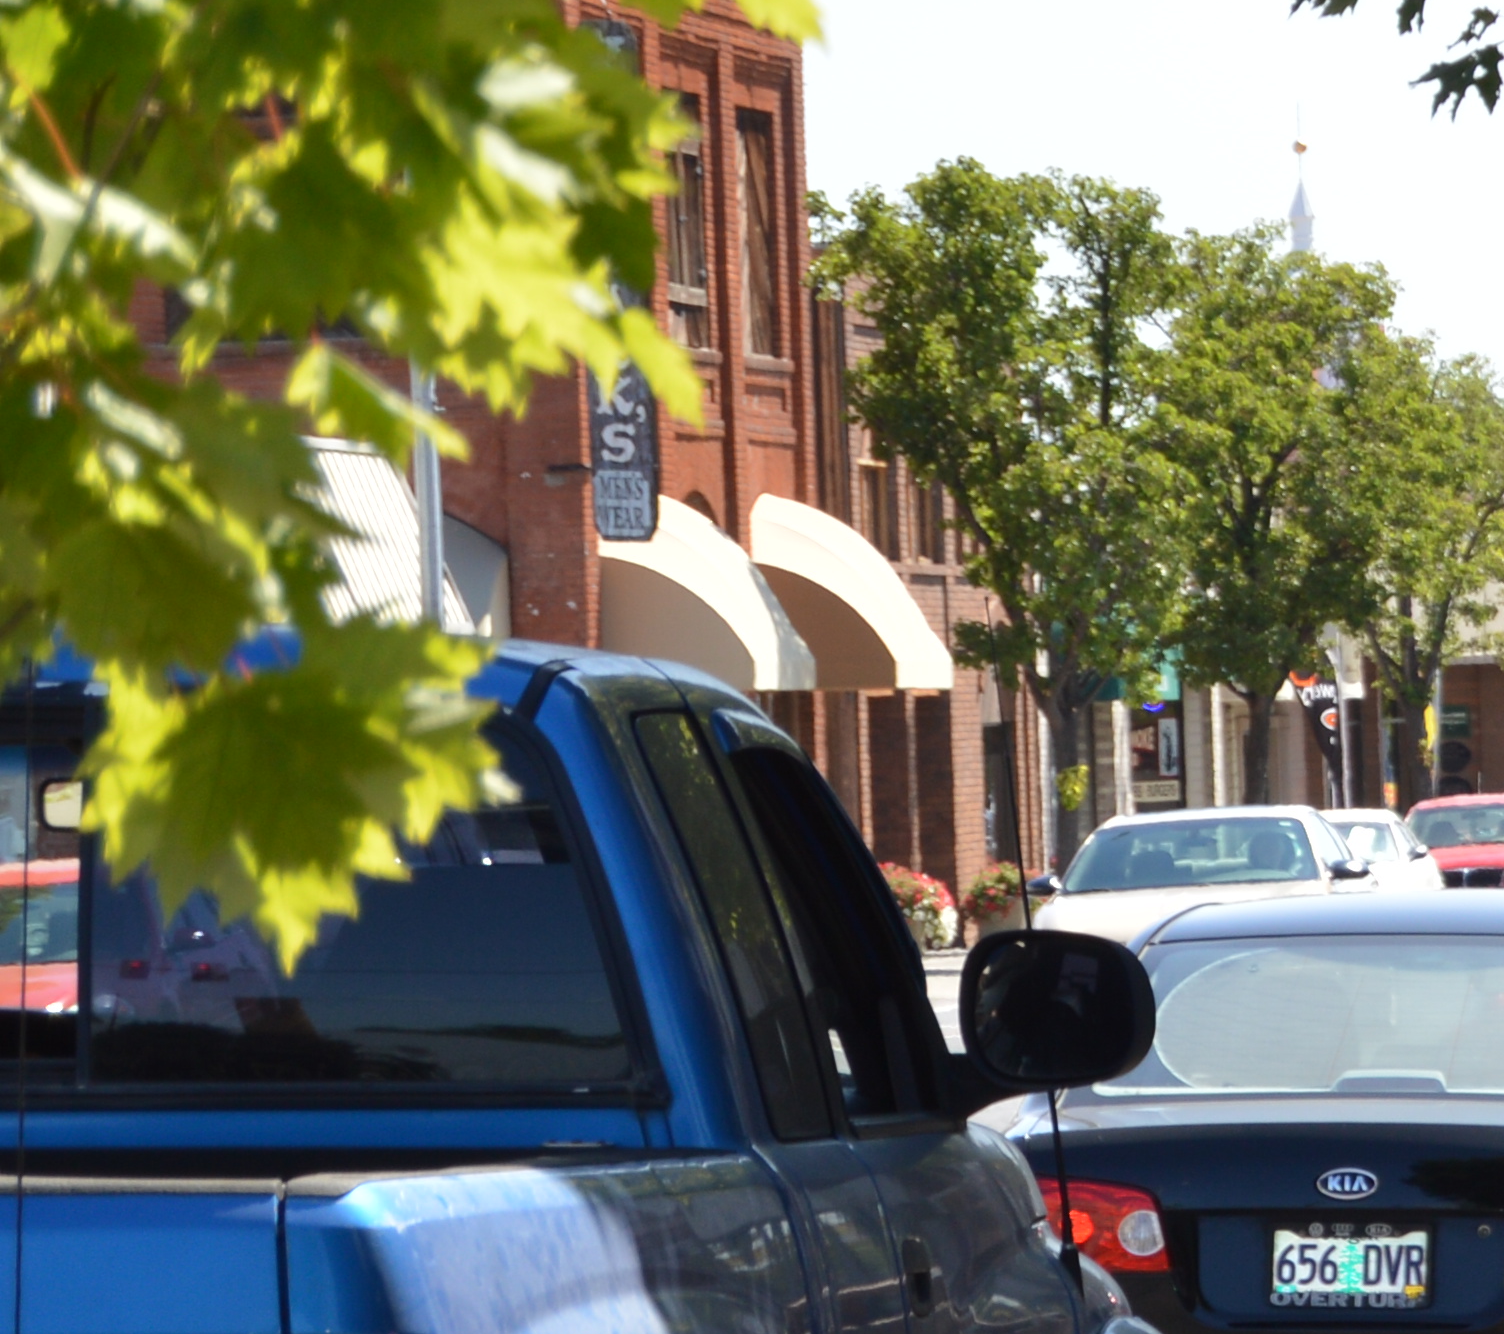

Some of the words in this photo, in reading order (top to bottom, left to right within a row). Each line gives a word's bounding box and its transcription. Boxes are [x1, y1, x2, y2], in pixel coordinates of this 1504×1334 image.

[1327, 1174, 1369, 1192] KIA
[1276, 1244, 1338, 1285] 656
[1363, 1244, 1425, 1286] DVR
